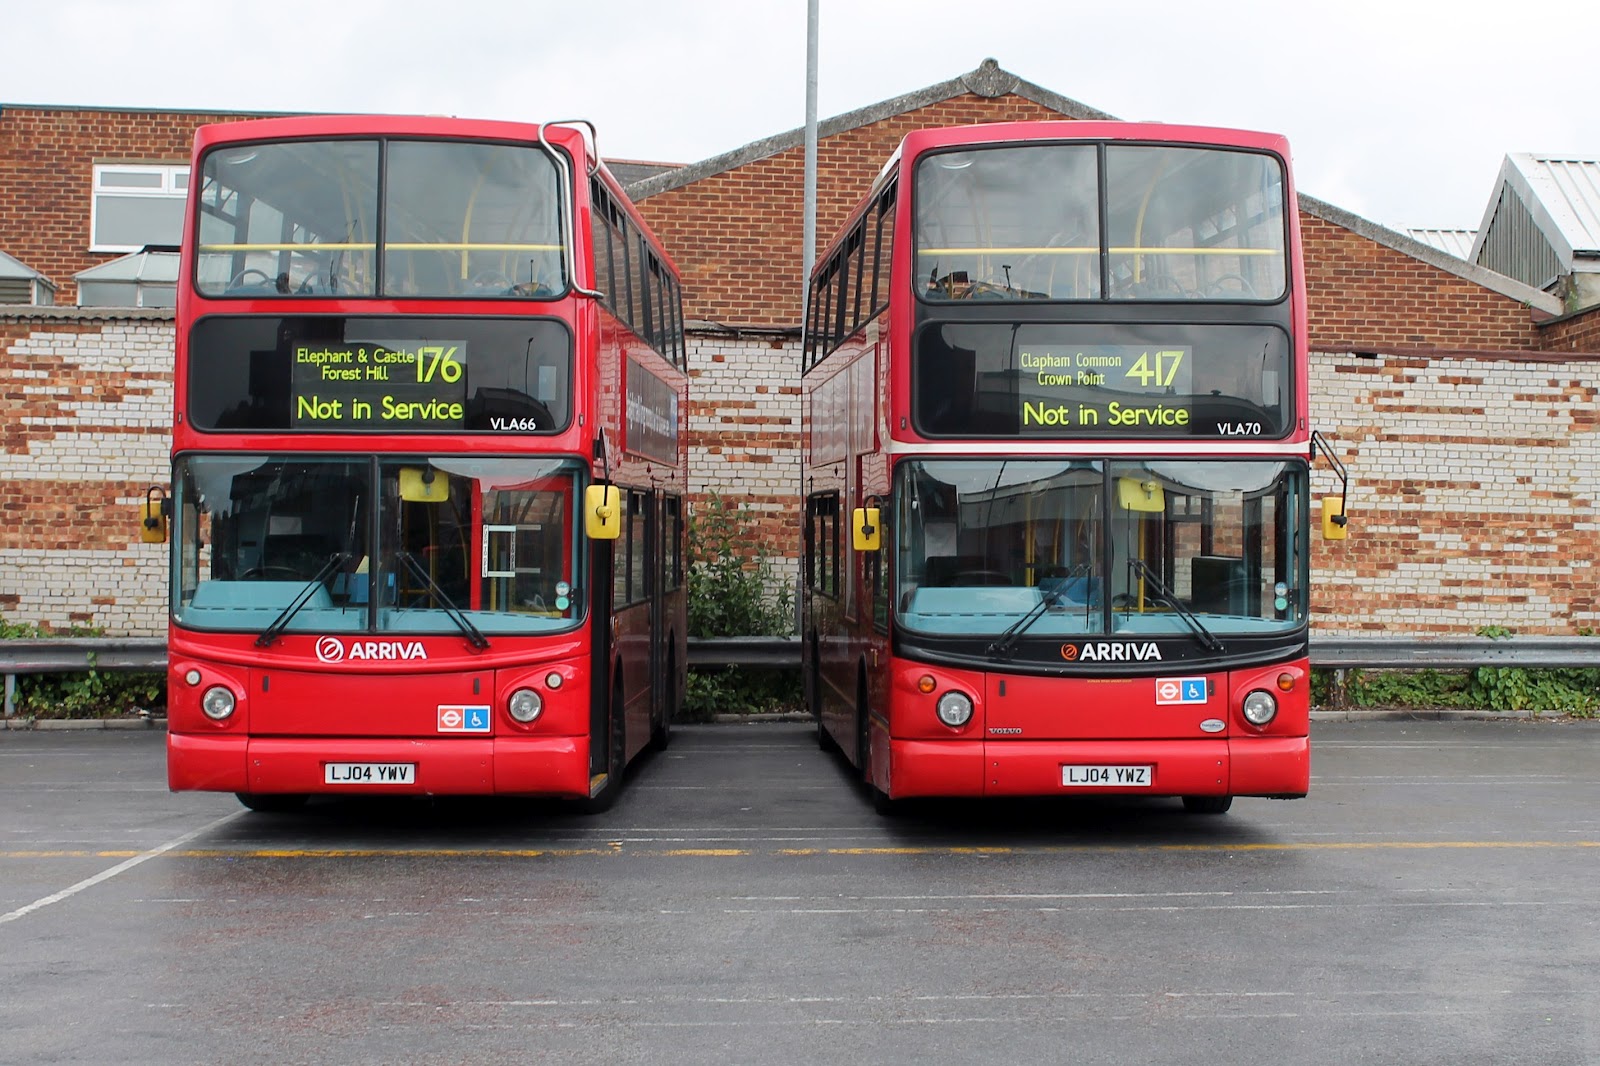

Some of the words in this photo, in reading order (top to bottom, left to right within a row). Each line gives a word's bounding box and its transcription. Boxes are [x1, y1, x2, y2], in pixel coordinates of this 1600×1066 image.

[297, 348, 352, 366] Elephant
[358, 349, 367, 363] &
[373, 348, 415, 363] Castle
[416, 346, 462, 382] 176
[1021, 352, 1070, 370] Clapham
[1076, 352, 1122, 367] Common
[322, 365, 361, 380] Forest
[366, 366, 388, 380] Hill
[1125, 350, 1184, 386] 417
[1037, 371, 1072, 385] Crown
[1077, 371, 1105, 385] Point
[297, 396, 342, 419] Not
[352, 398, 371, 419] in
[381, 396, 463, 420] Service
[1023, 402, 1069, 426] Not
[1079, 404, 1098, 425] in
[1108, 402, 1189, 426] Service
[490, 417, 536, 431] VLA66
[1217, 422, 1261, 436] VLA70
[348, 642, 427, 660] ARRIVA
[1079, 642, 1162, 661] ARRIVA
[988, 727, 1022, 735] VOLVO
[332, 766, 372, 780] LJ04
[378, 766, 408, 780] YWV
[1069, 768, 1110, 782] LJ04
[1116, 768, 1145, 782] YWZ
